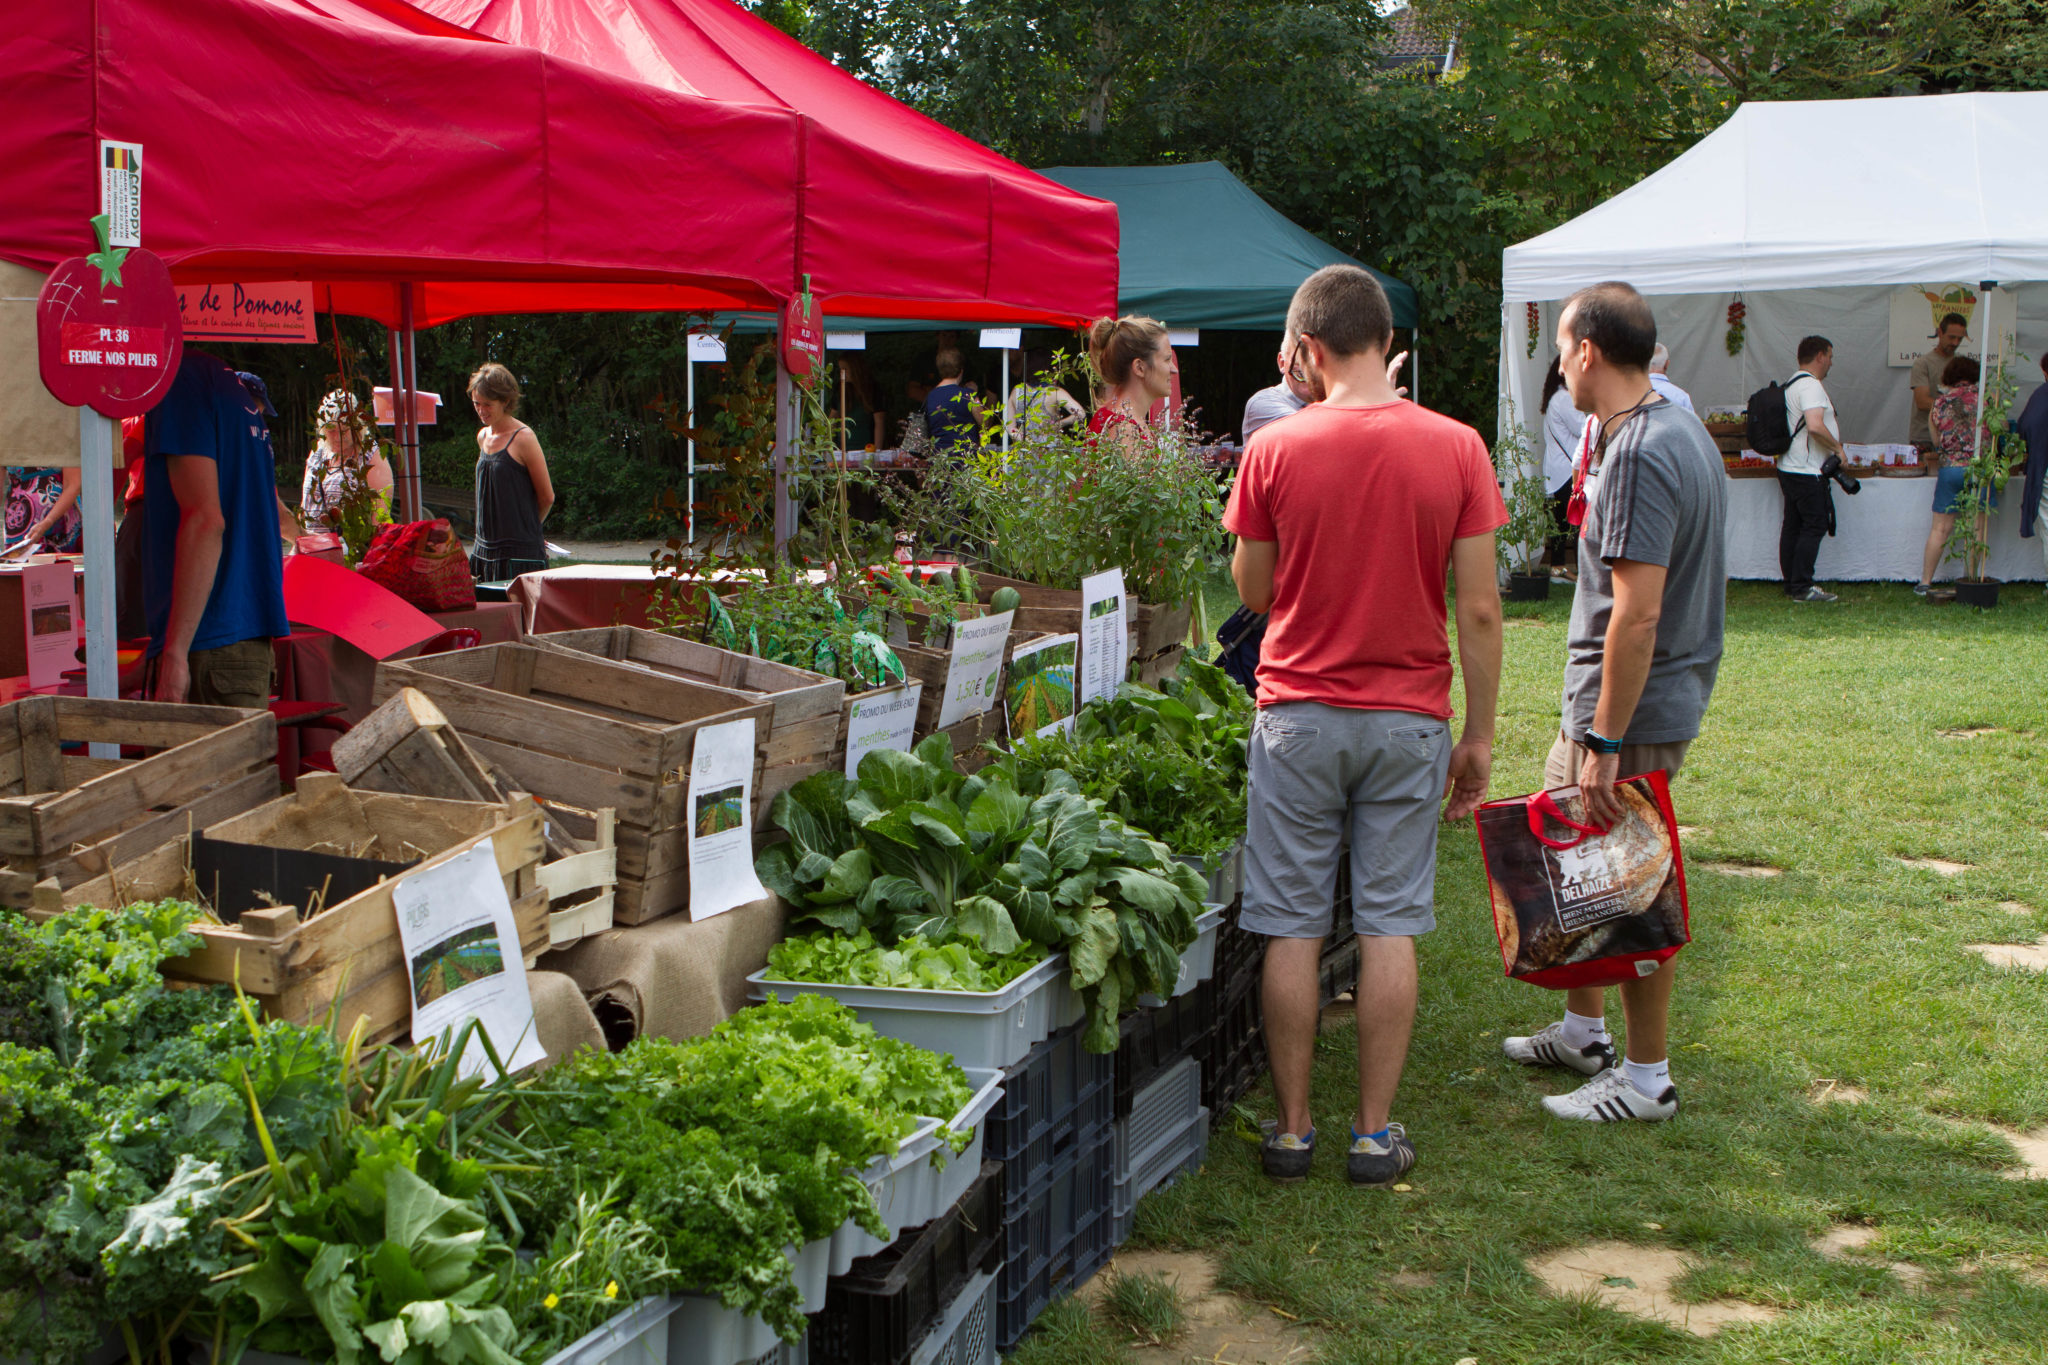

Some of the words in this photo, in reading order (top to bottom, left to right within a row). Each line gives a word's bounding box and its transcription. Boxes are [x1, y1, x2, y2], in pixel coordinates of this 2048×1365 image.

[129, 174, 139, 239] canopy
[200, 283, 221, 311] de
[233, 282, 303, 317] Pomone
[100, 328, 113, 342] PL
[115, 329, 129, 343] 36
[69, 349, 103, 364] FERME
[105, 351, 126, 365] NOS
[128, 352, 158, 367] PILIFS
[1900, 352, 1910, 360] La
[1967, 352, 2000, 362] Potger
[962, 629, 981, 640] PROMO
[981, 628, 988, 637] DU
[989, 621, 1009, 635] WEEK-END
[958, 650, 987, 666] menthes
[859, 706, 880, 720] PROMO
[880, 704, 888, 715] DU
[889, 698, 915, 712] WEEK-END
[857, 728, 891, 749] menthes
[1561, 877, 1615, 903] DELHAIZE
[1562, 908, 1583, 920] BIEN
[1565, 916, 1586, 928] BIEN
